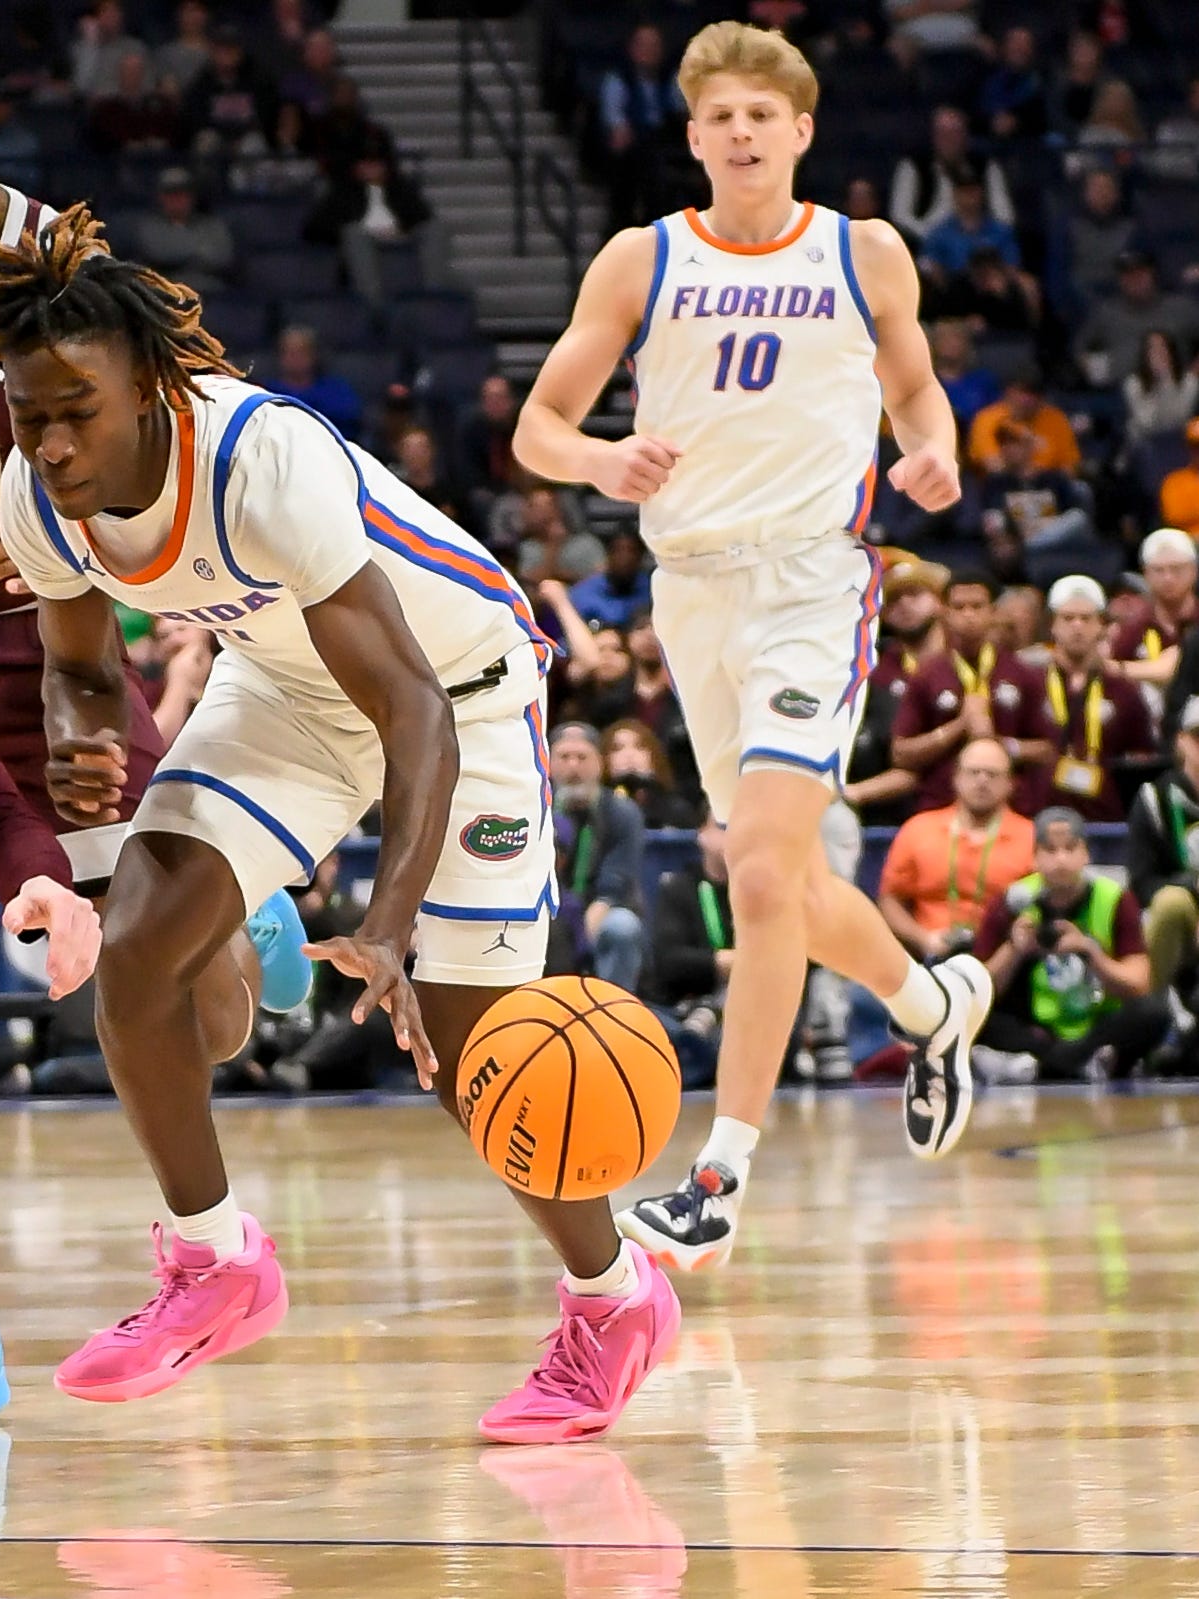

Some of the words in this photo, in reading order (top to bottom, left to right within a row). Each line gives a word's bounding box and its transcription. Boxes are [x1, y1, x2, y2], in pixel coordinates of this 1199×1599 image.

[670, 285, 836, 320] FLORIDA
[713, 332, 782, 392] 10
[158, 591, 281, 623] RIDA
[516, 1094, 532, 1125] NXT
